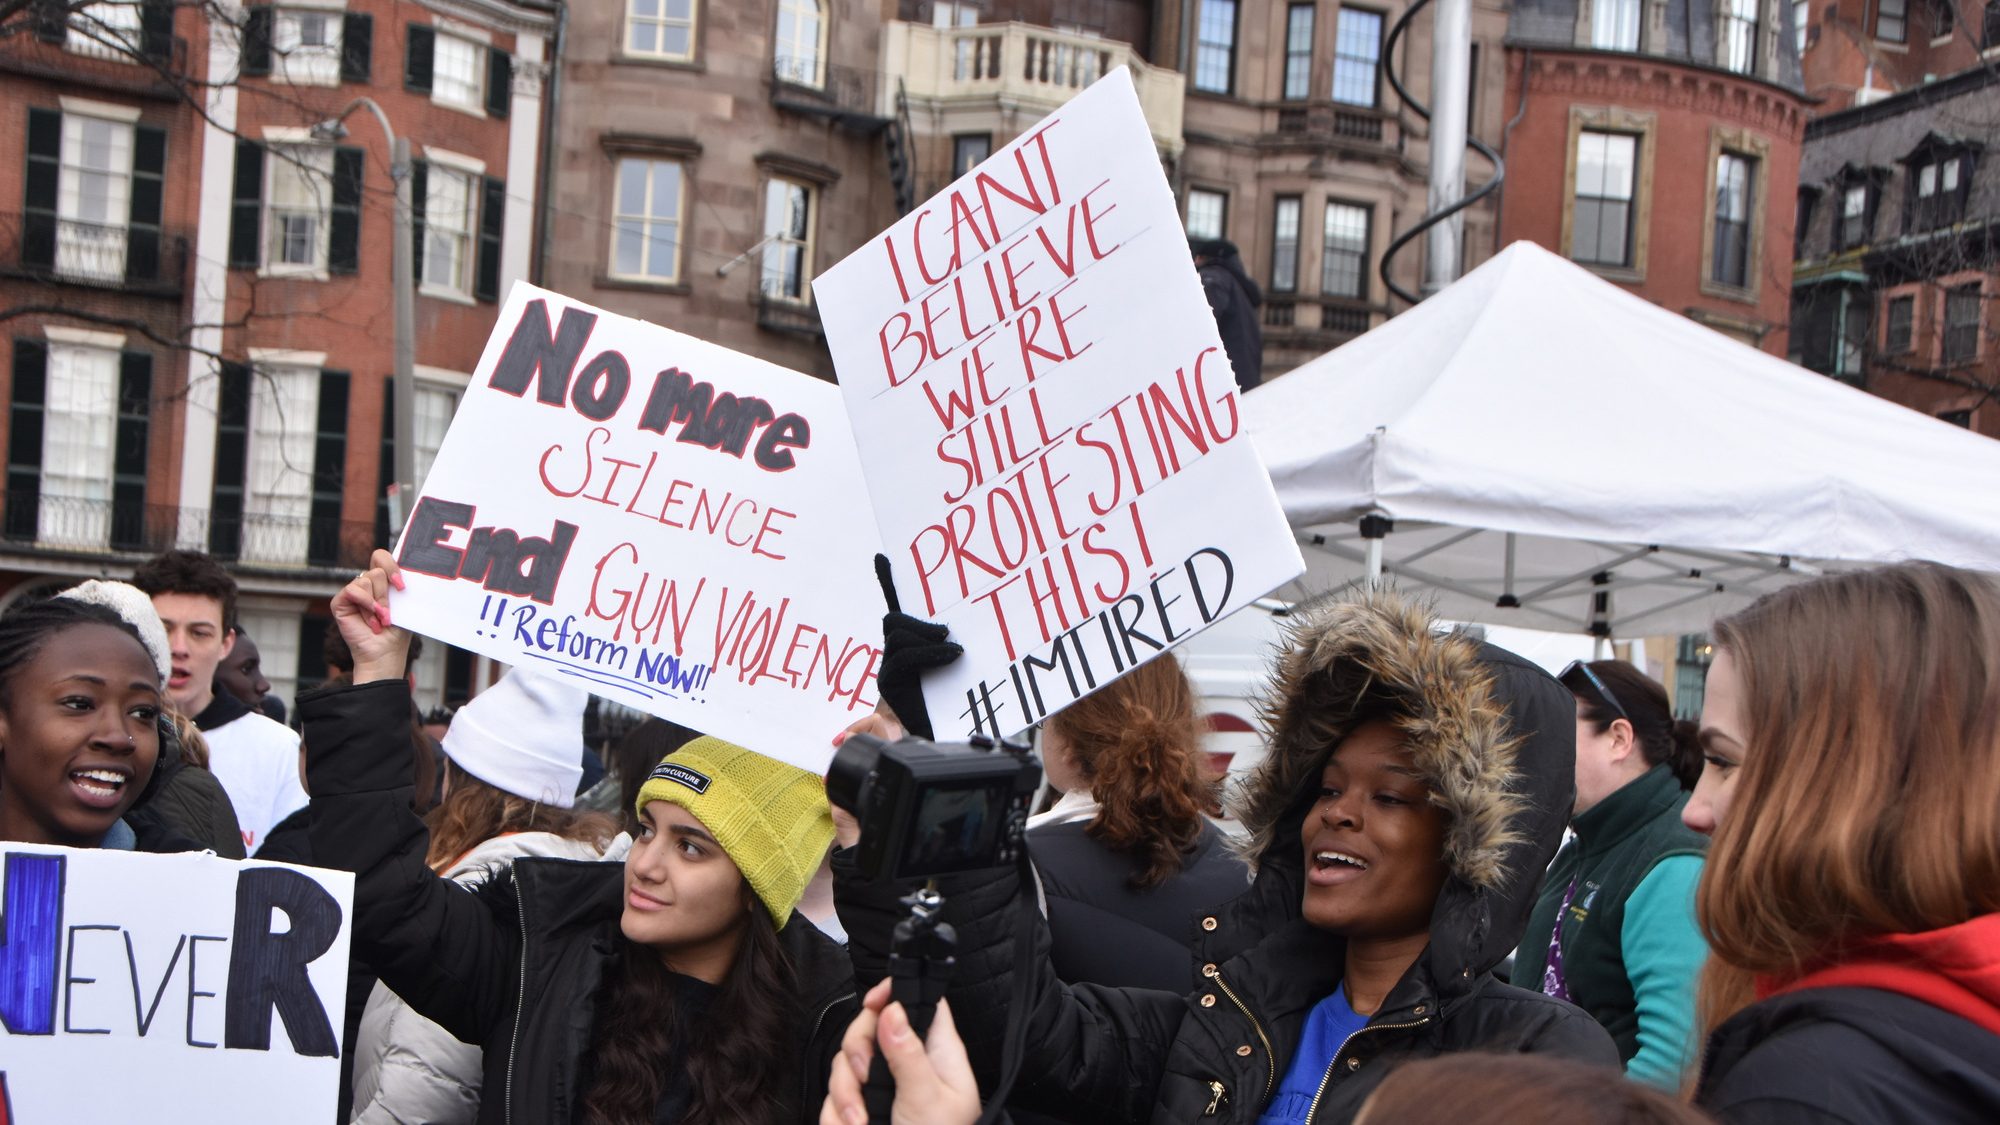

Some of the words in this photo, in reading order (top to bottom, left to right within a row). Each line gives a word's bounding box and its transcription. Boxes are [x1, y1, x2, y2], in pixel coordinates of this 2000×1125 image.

[879, 178, 1120, 388] BELIEVE
[884, 235, 910, 304] I
[914, 119, 1061, 286] CANT
[487, 298, 631, 422] No
[638, 366, 811, 473] more
[922, 278, 1093, 432] WE'RE
[539, 427, 797, 561] SILENCE
[910, 347, 1239, 617] PROTESTING
[937, 387, 1073, 504] STILL
[399, 496, 579, 605] End
[584, 542, 706, 656] GUN
[711, 586, 884, 711] VIOLENCE
[959, 547, 1234, 740] #IMTIRED
[971, 501, 1158, 662] THIS!
[670, 769, 701, 785] CULTURE
